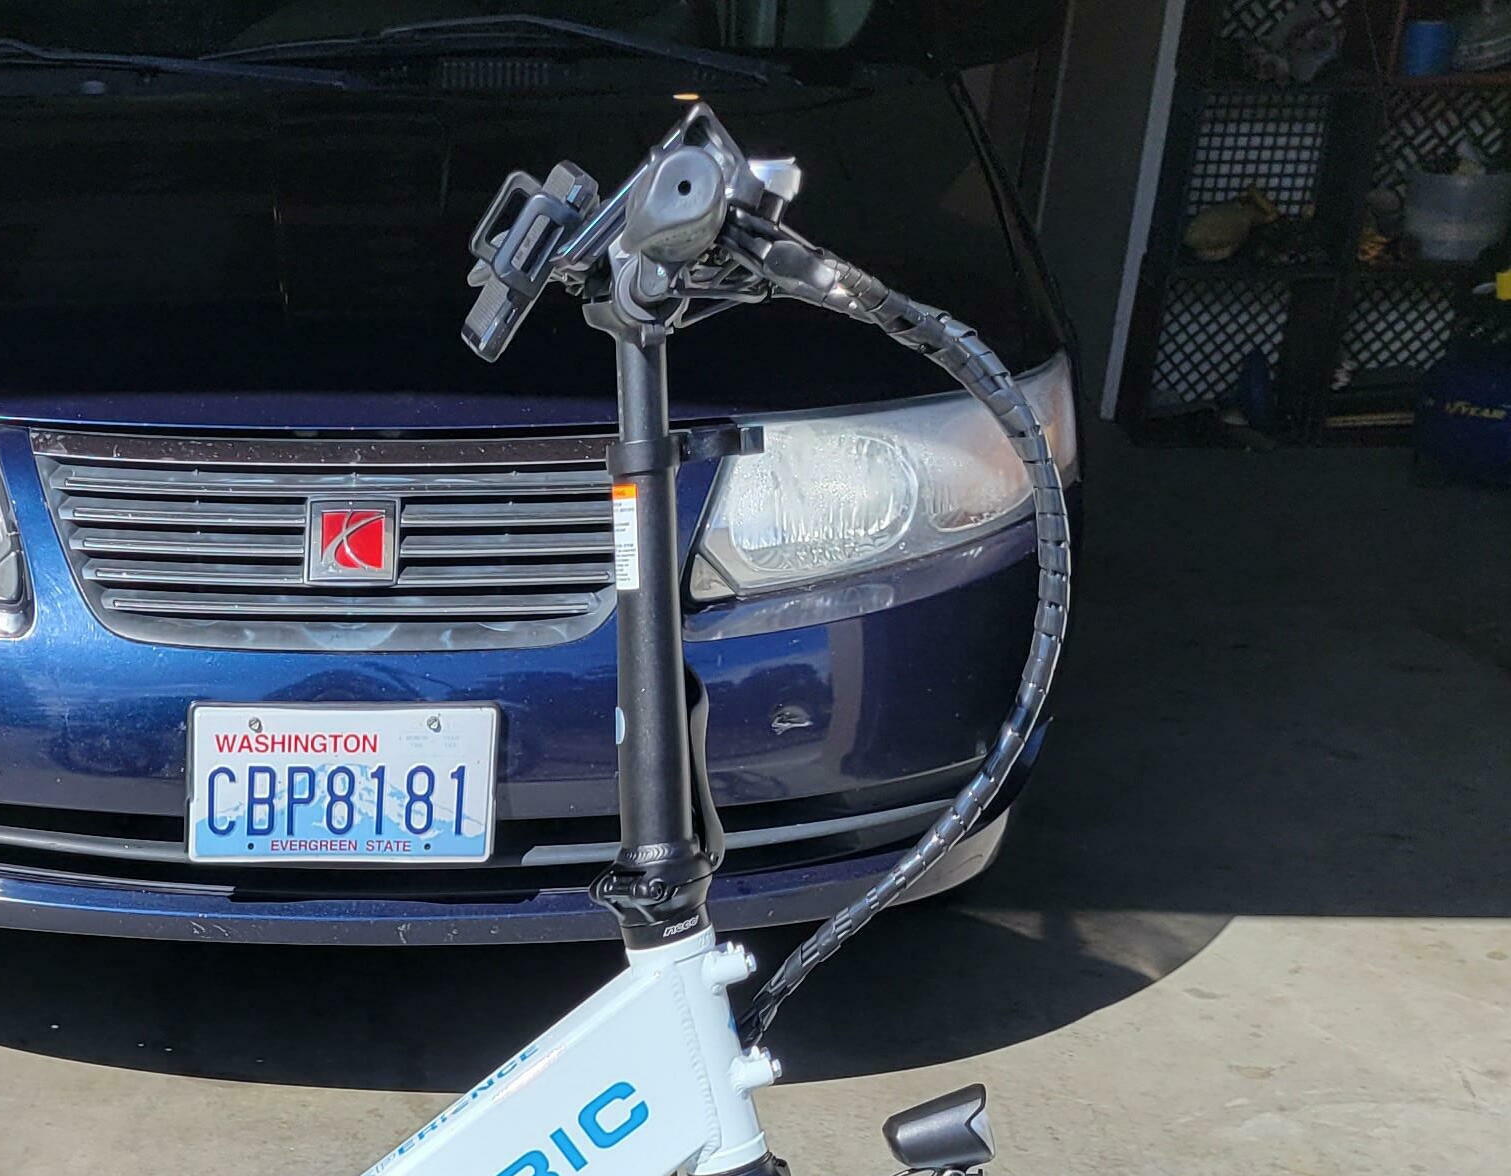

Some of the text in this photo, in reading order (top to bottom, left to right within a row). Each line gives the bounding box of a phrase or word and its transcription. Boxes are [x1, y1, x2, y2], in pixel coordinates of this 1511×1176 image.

[215, 734, 378, 753] WASHINGTON
[207, 765, 467, 836] CBP8181
[270, 839, 412, 852] EVERGREEN STATE
